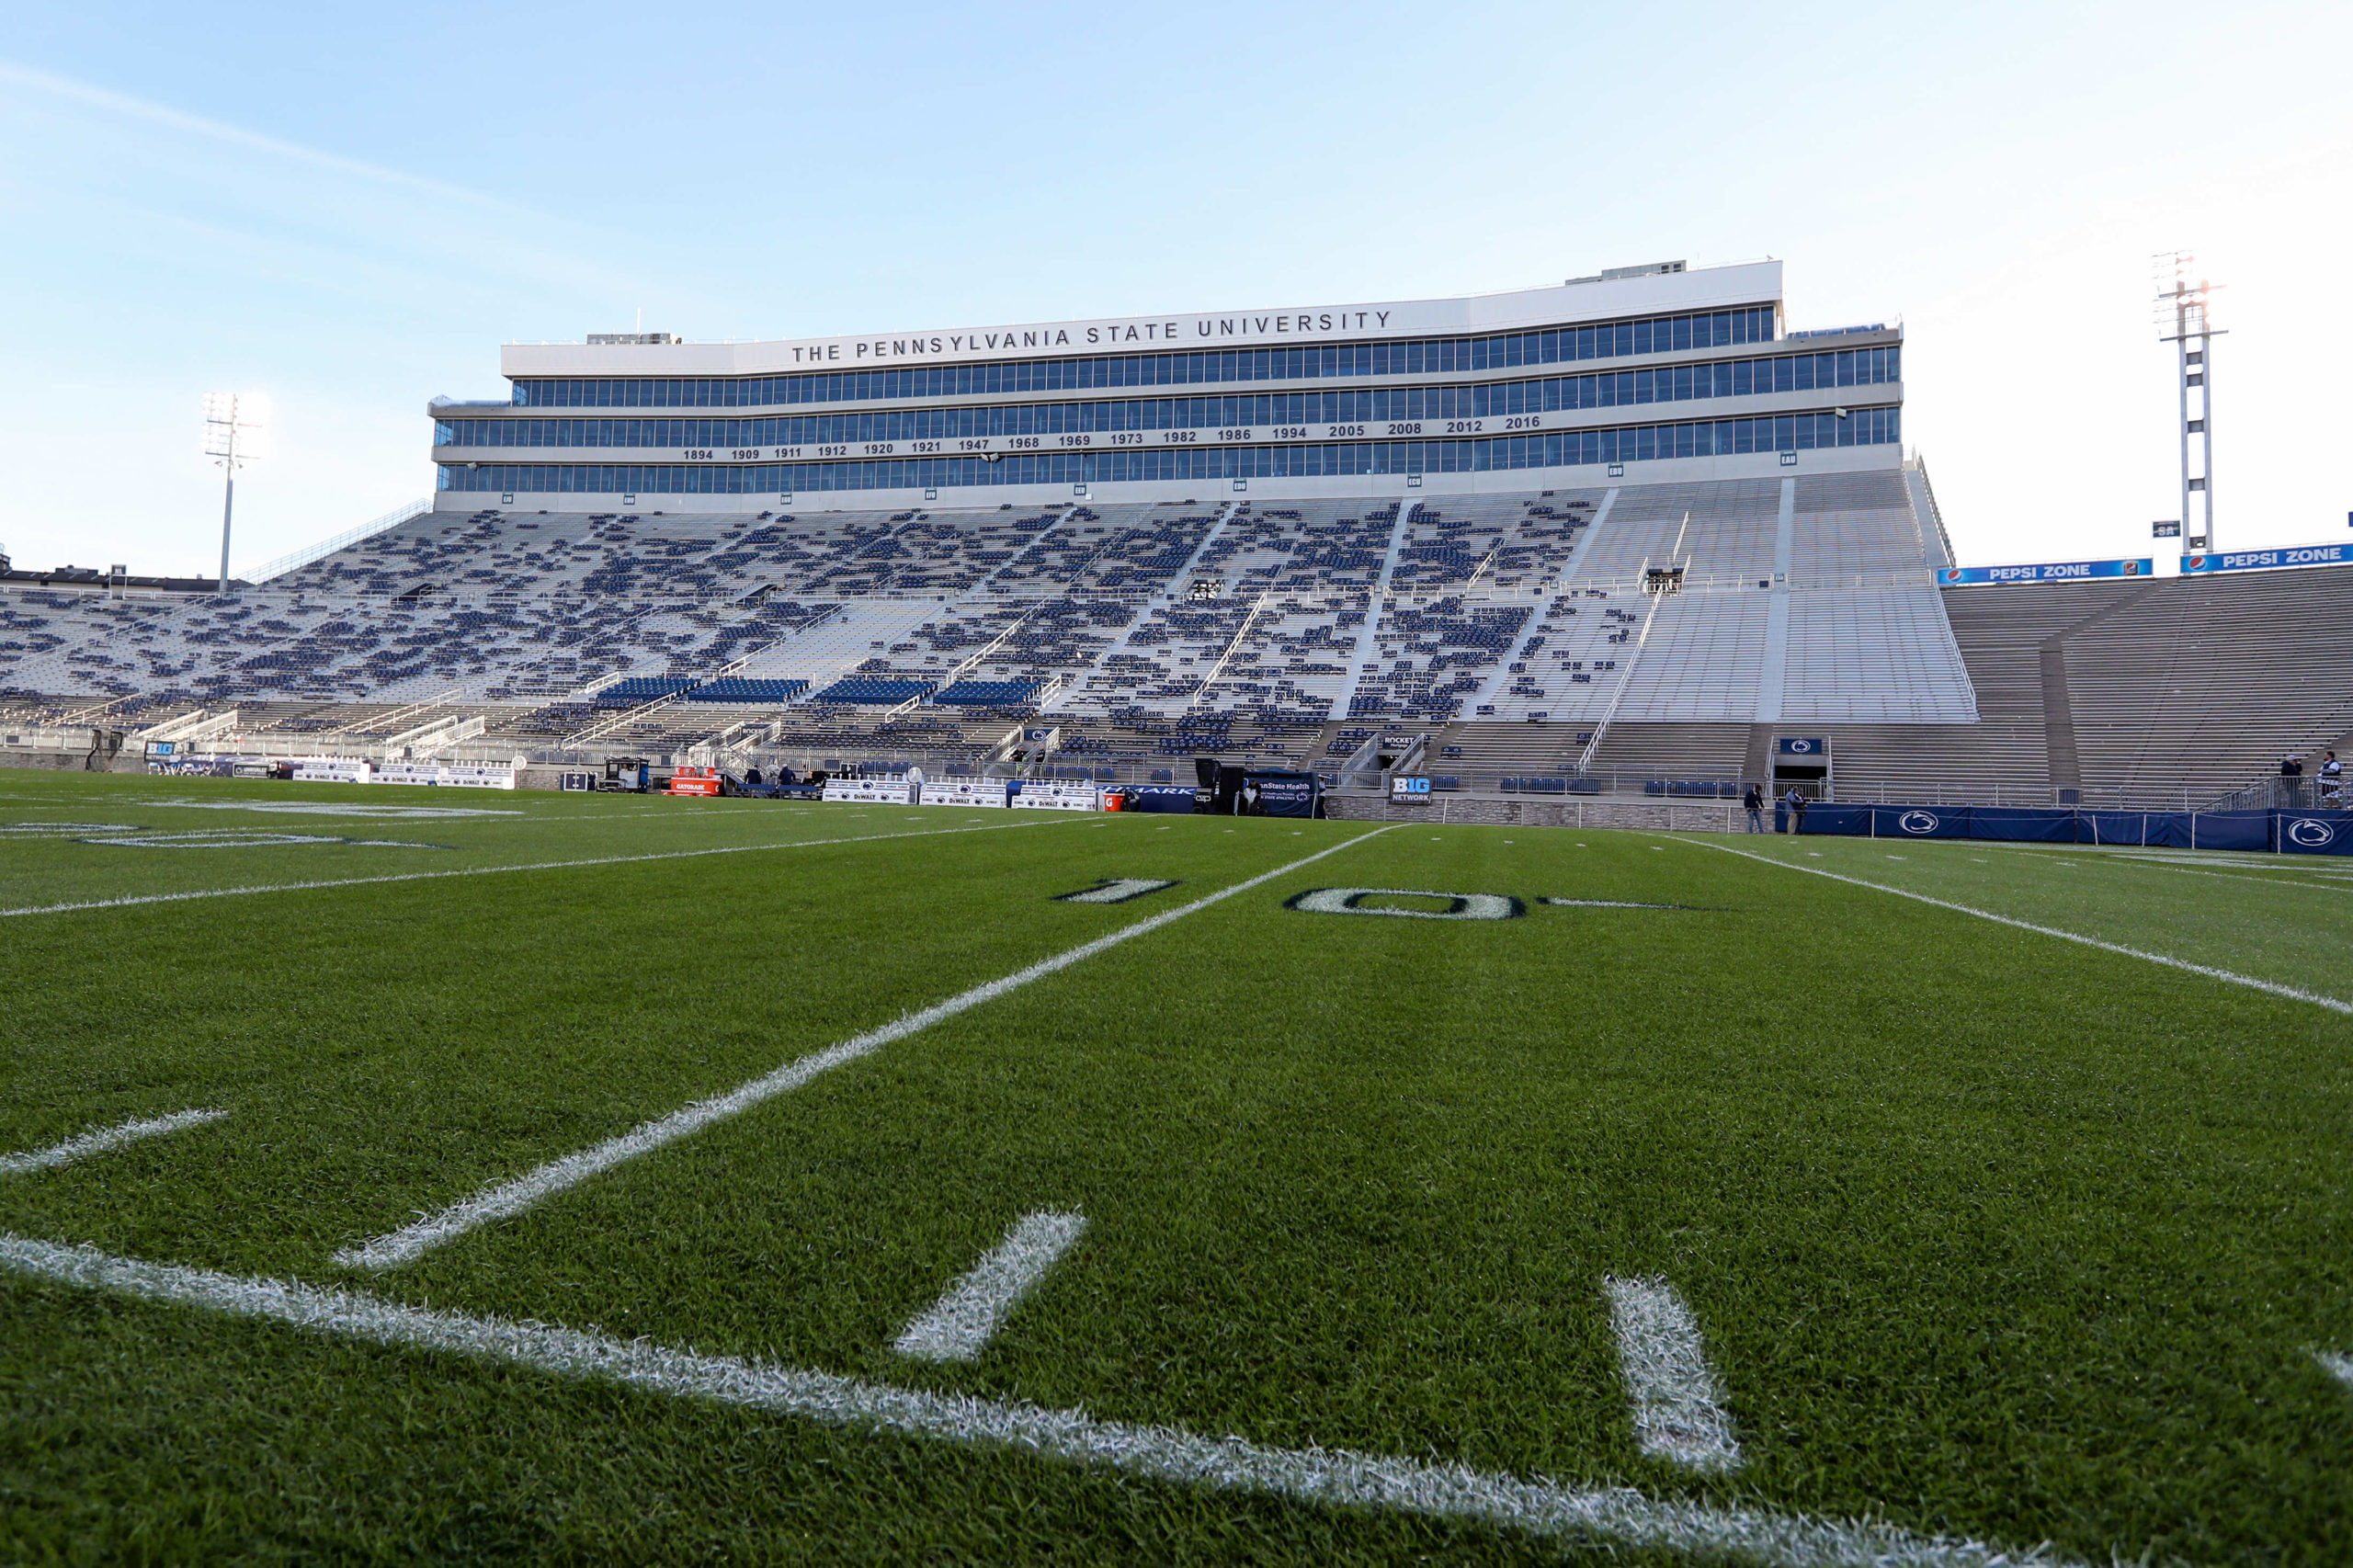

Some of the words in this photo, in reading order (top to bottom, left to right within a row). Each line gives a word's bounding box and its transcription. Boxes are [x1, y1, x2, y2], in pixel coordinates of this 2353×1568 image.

[792, 345, 840, 363] THE
[856, 329, 1070, 358] PENNSYLVANIA
[1086, 323, 1177, 344] STATE
[1198, 311, 1392, 337] UNIVERSITY
[684, 449, 713, 460] 1894
[732, 449, 759, 460] 1909
[775, 448, 801, 458] 1911
[818, 446, 847, 457] 1912
[864, 443, 893, 454] 1920
[911, 441, 940, 452] 1921
[959, 439, 989, 450] 1947
[1008, 437, 1040, 449] 1968
[1059, 435, 1091, 447] 1969
[1110, 433, 1142, 445] 1973
[1163, 431, 1197, 443] 1982
[1218, 428, 1251, 441] 1986
[1272, 426, 1307, 439] 1994
[1329, 425, 1365, 437] 2005
[1388, 423, 1422, 436] 2008
[1447, 420, 1483, 434] 2012
[1505, 415, 1540, 429] 2016
[1781, 455, 1796, 464] EAU
[2222, 551, 2278, 567] PEPSI
[2286, 548, 2342, 563] ZONE
[1989, 567, 2037, 580] PEPSI
[2043, 564, 2091, 577] ZONE
[1106, 797, 1113, 807] G
